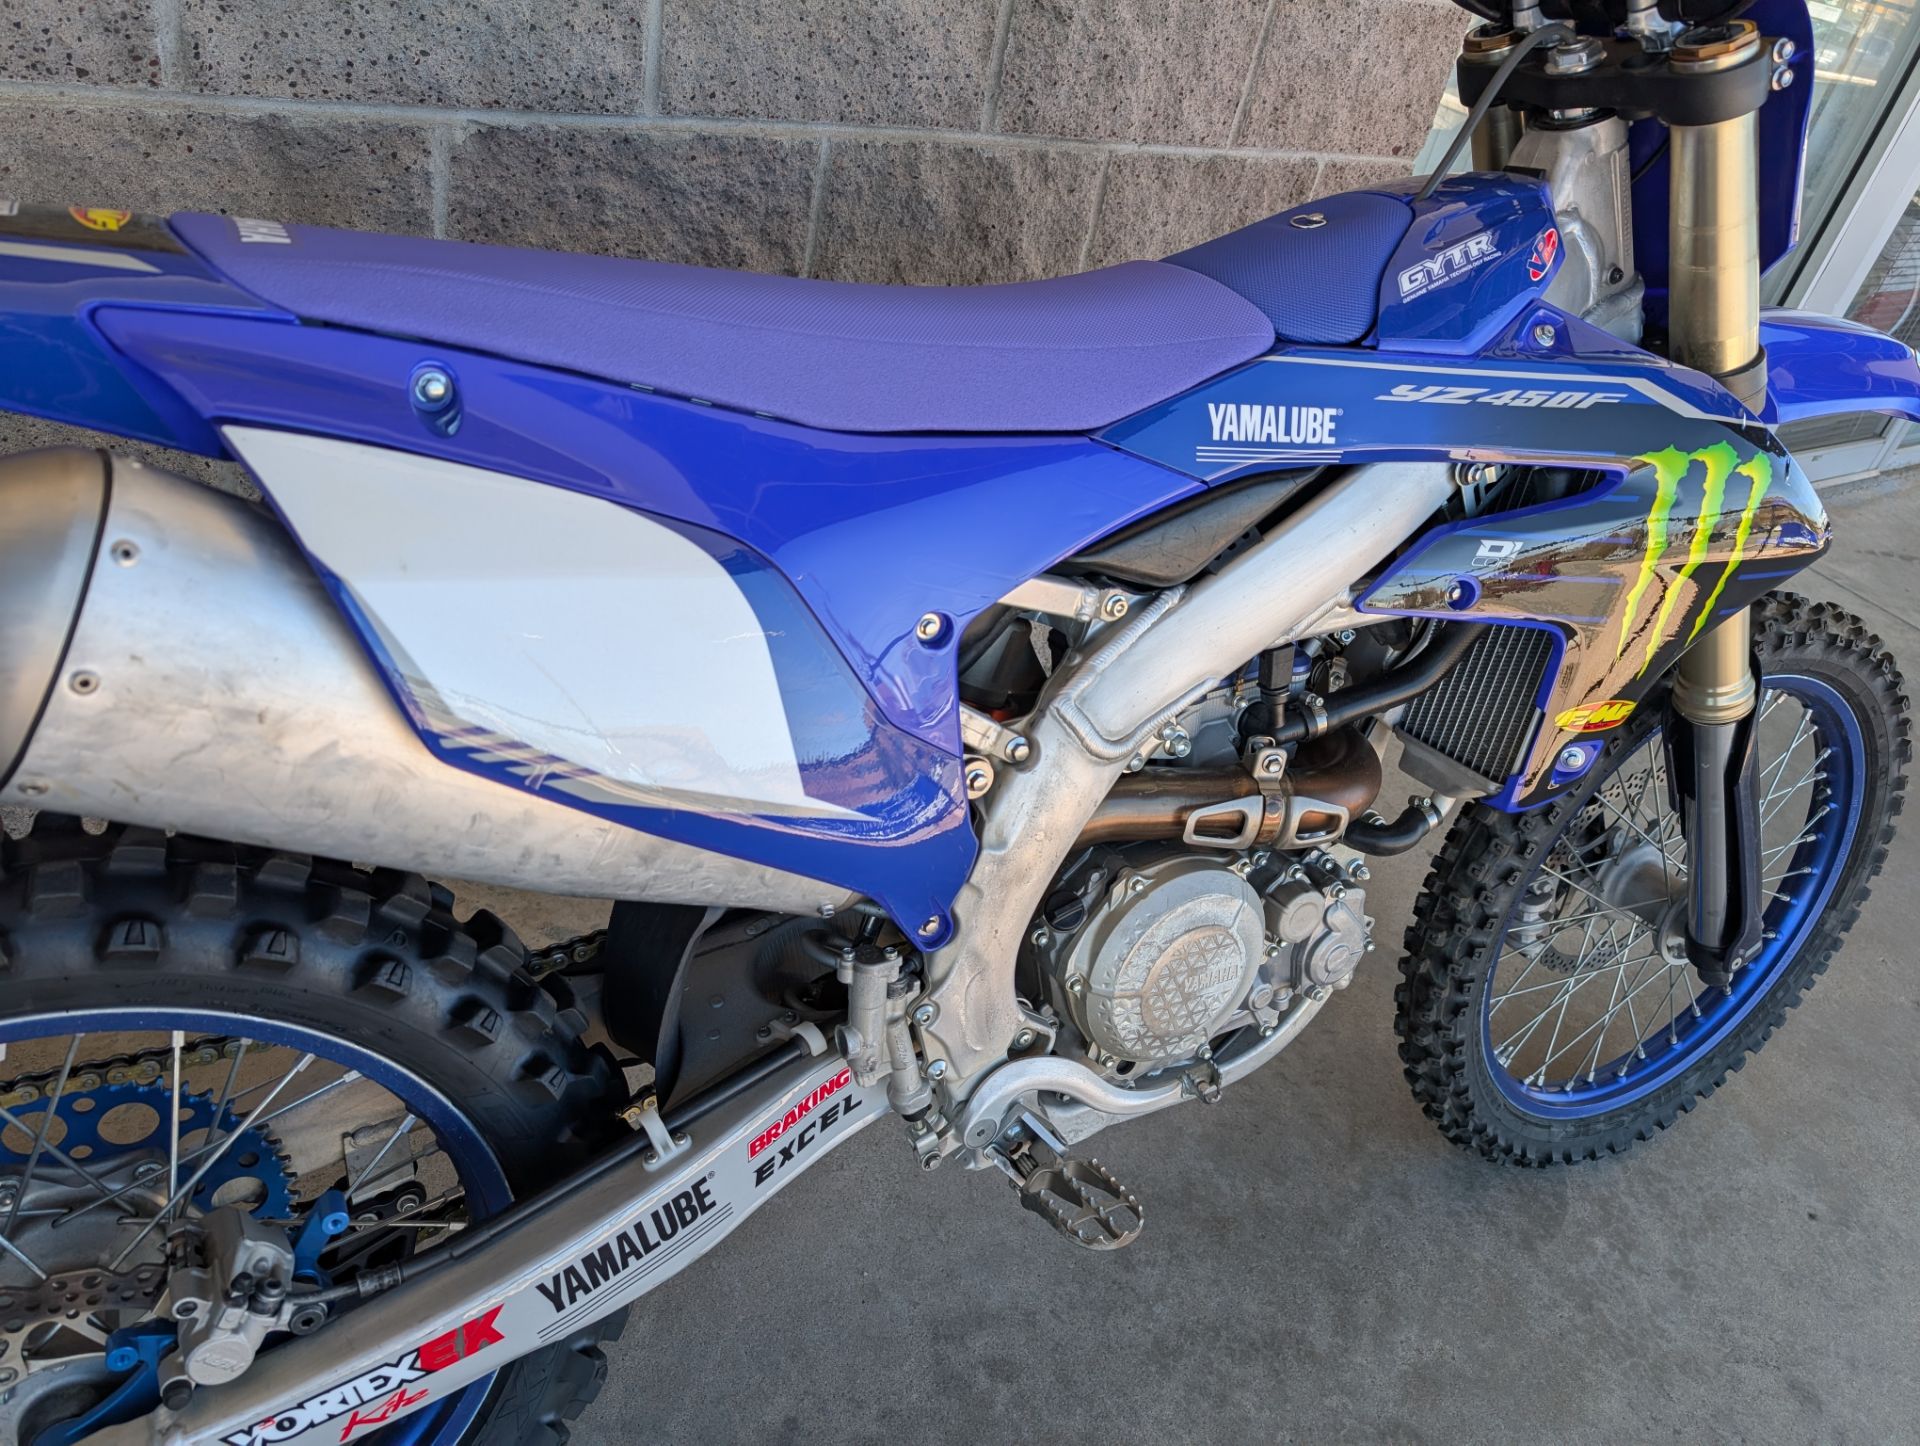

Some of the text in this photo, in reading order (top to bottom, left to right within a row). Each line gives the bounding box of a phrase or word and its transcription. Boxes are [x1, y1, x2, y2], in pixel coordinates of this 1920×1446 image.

[1398, 233, 1497, 297] GYTR
[1207, 402, 1338, 444] YAMALUBE
[1556, 701, 1638, 730] FMF
[1184, 963, 1239, 993] YAMAHA
[748, 1067, 852, 1162] BRAKING
[755, 1094, 863, 1188] EXCEL
[536, 1175, 717, 1314] YAMALUBE
[219, 1348, 430, 1446] VORTEX
